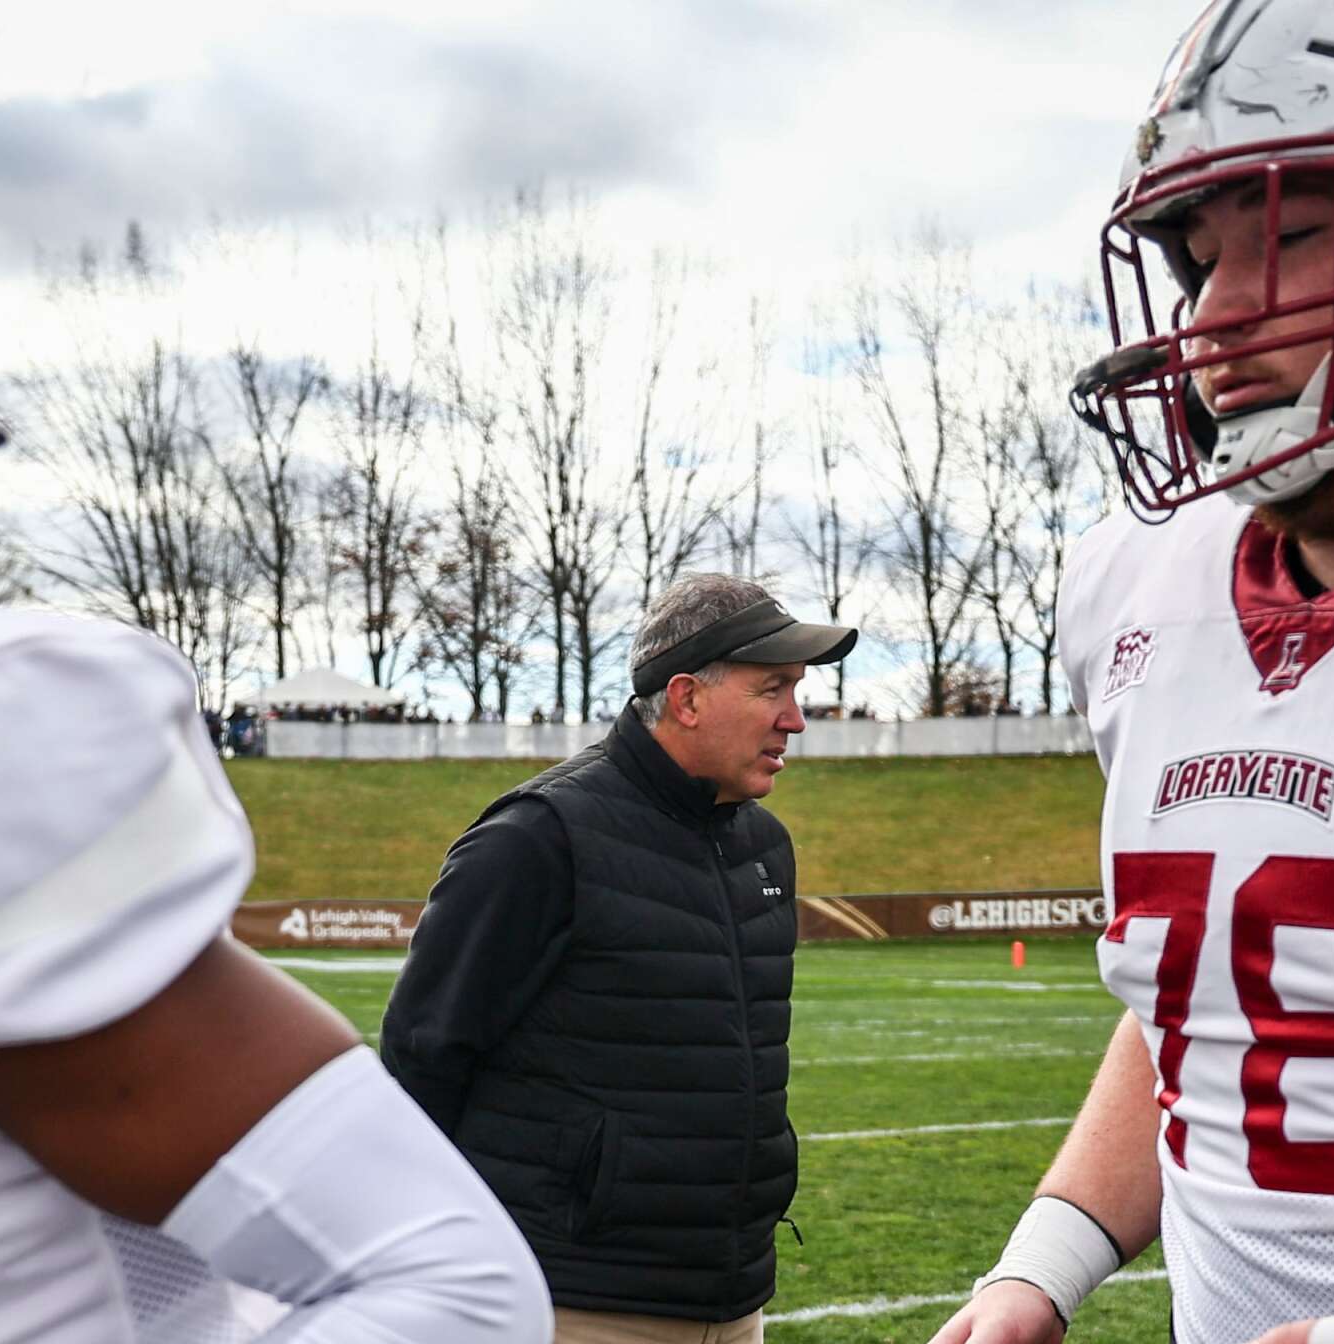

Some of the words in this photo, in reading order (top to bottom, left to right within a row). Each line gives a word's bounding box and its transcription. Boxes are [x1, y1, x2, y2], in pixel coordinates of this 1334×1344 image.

[310, 909, 358, 926] Lehigh
[360, 909, 402, 926] Valley
[312, 925, 391, 940] Orthopedic
